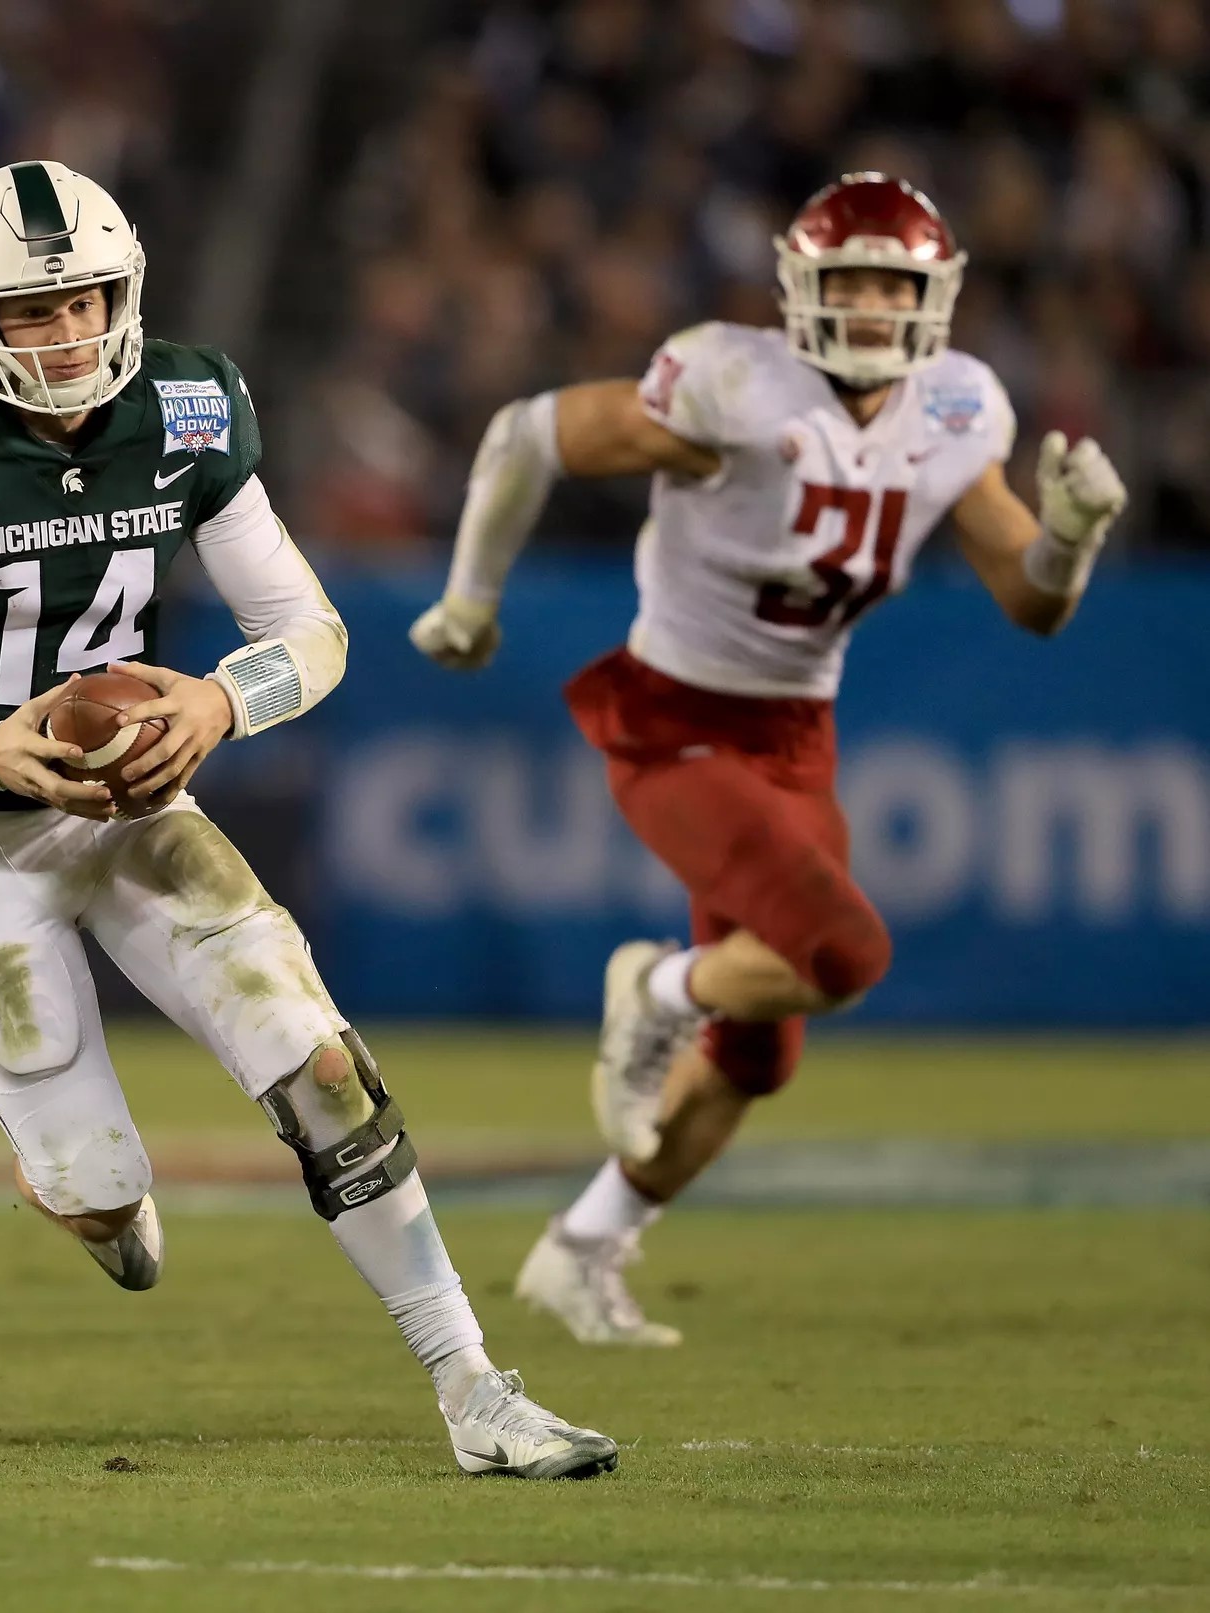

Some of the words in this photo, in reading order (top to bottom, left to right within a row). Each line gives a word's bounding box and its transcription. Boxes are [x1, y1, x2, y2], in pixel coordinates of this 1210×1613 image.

[45, 261, 64, 271] MSU
[161, 398, 228, 423] HOLIDAY
[176, 418, 221, 432] BOWL
[111, 501, 184, 540] STATE
[754, 482, 908, 628] 31
